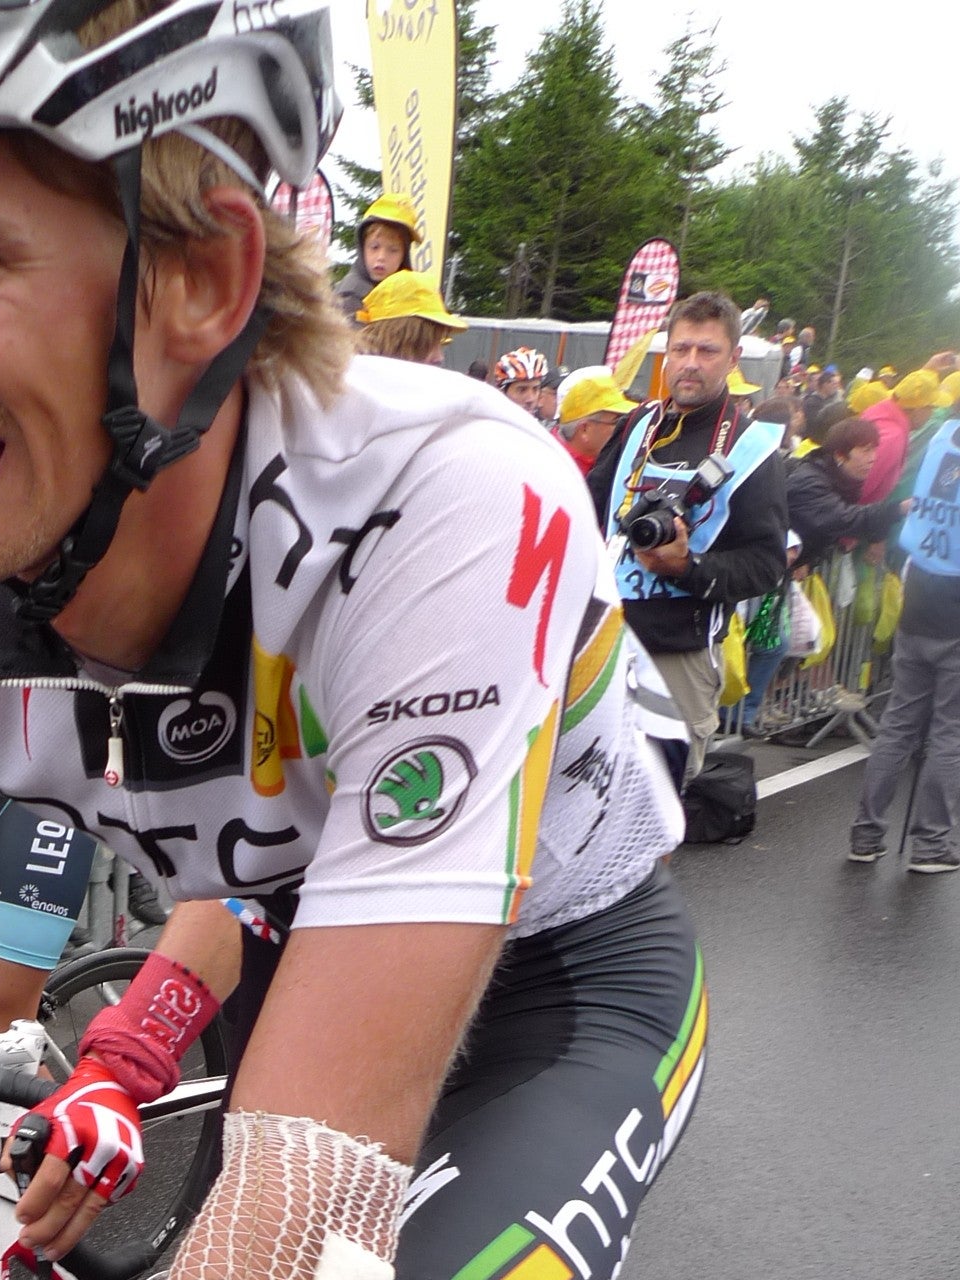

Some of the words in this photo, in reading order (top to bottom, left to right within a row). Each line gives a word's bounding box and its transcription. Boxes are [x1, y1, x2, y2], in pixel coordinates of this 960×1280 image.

[114, 65, 217, 142] highroad
[919, 527, 948, 560] 40
[170, 713, 223, 743] MOA
[31, 899, 70, 917] enovos
